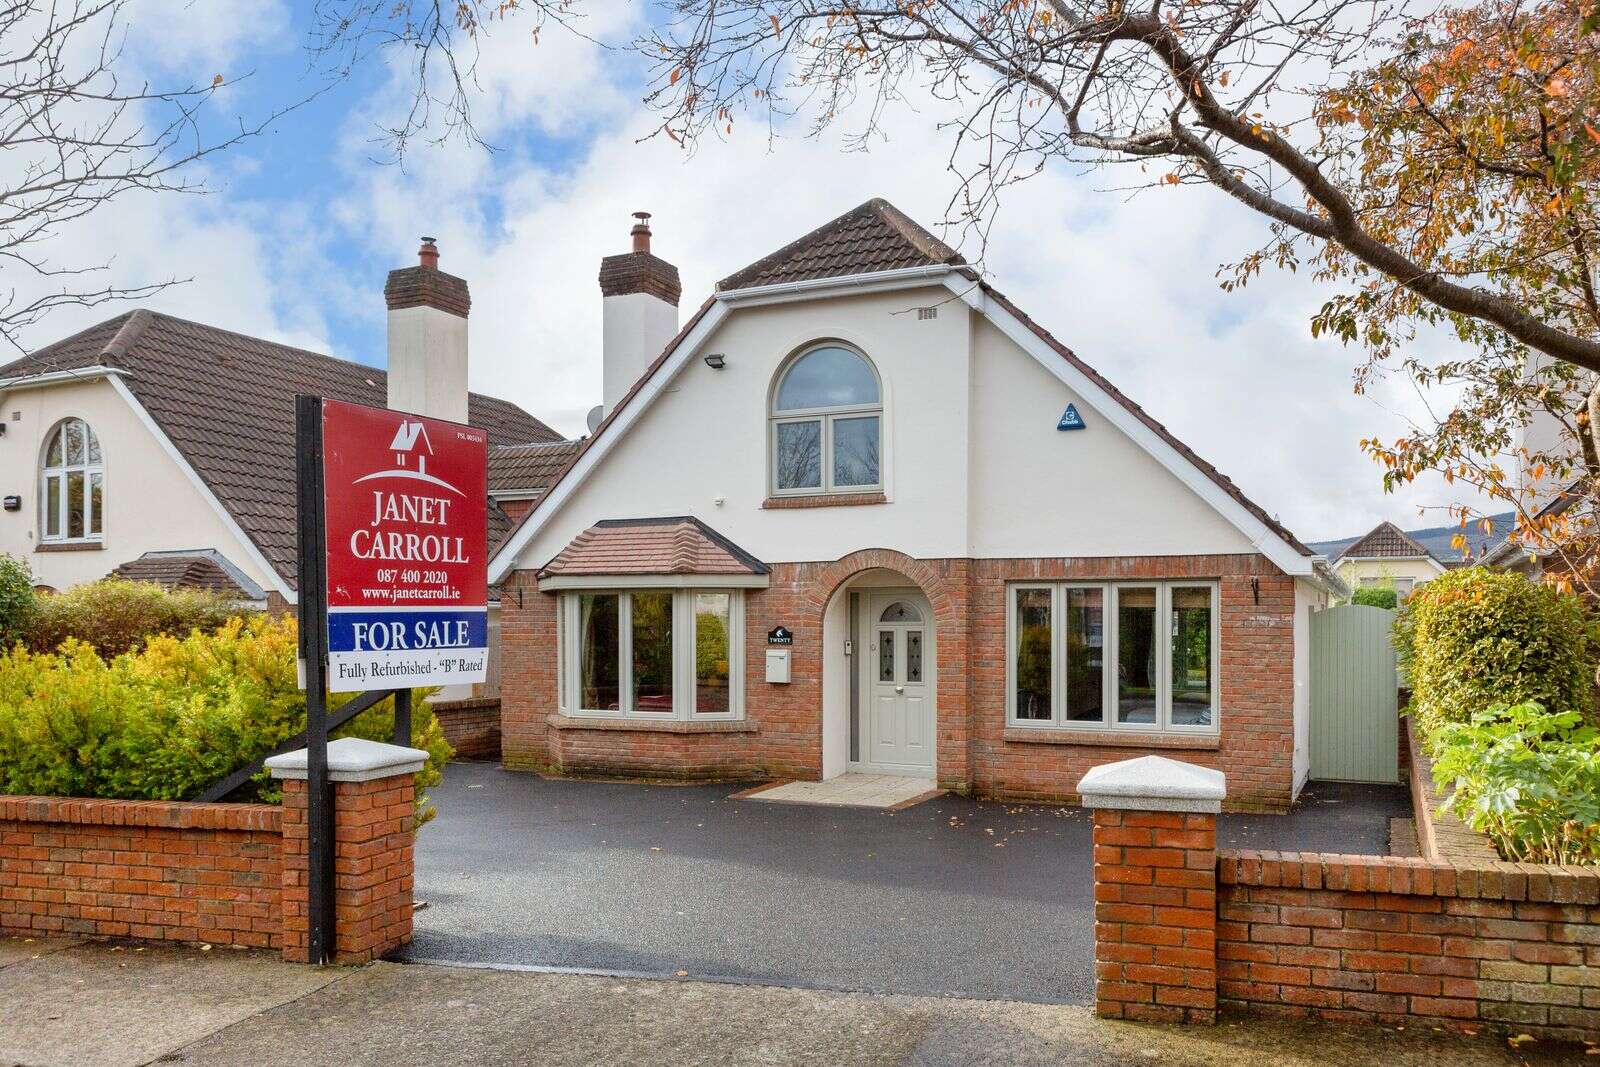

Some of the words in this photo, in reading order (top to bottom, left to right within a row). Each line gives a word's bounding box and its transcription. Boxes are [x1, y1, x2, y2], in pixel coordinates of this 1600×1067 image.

[371, 491, 451, 527] JANET
[351, 530, 469, 564] CARROLL
[377, 569, 397, 584] 087
[401, 569, 420, 584] 400
[424, 570, 448, 584] 2020
[362, 585, 461, 603] www.janetcarroll.ie
[352, 622, 409, 651] FOR
[414, 620, 470, 649] SALE
[339, 663, 367, 682] Fully
[371, 659, 431, 678] Refurbished
[459, 658, 483, 673] Rated
